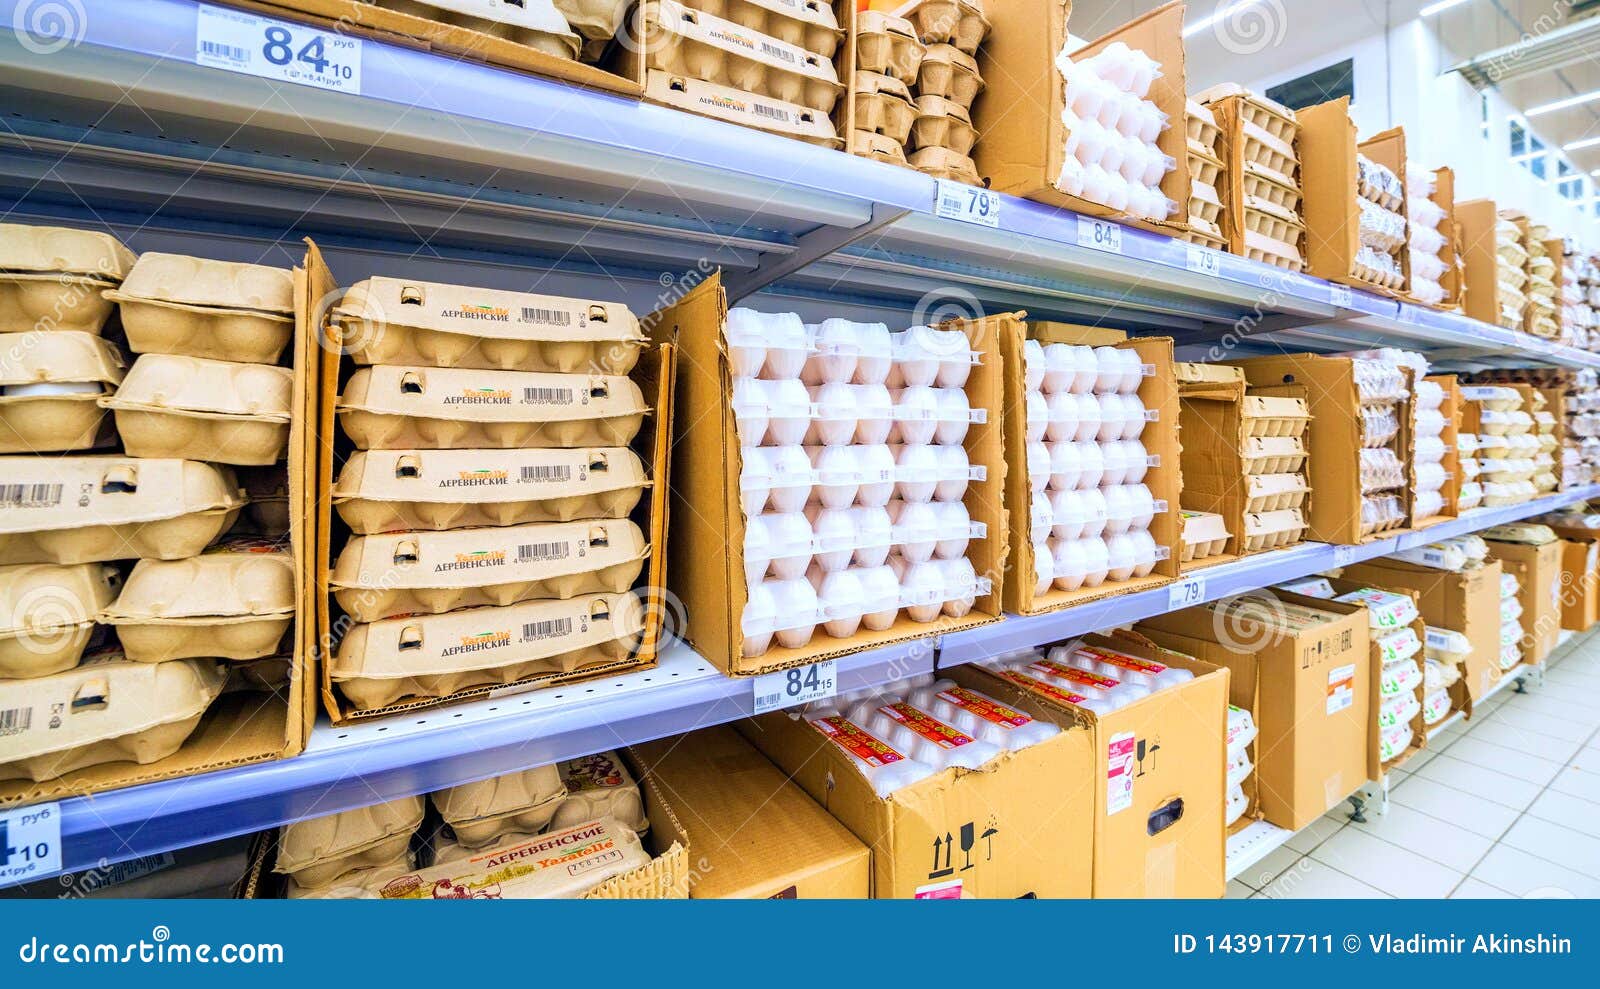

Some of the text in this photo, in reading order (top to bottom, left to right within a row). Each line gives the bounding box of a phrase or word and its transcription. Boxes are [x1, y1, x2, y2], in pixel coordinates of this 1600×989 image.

[263, 26, 329, 73] 84
[333, 38, 354, 49] руб
[331, 63, 352, 80] 10
[967, 189, 990, 217] 79
[1094, 222, 1113, 246] 84
[1199, 250, 1214, 270] 79
[441, 310, 510, 322] ДЕРЕВЕНСКИЕ
[443, 396, 512, 406] ДЕРЕВЕНСКИЕ
[439, 477, 509, 488] ДЕРЕВЕНСКИЕ
[434, 557, 506, 573] ДЕРЕВЕНСКИЕ
[1184, 582, 1199, 602] 79
[441, 637, 512, 658] ДЕРЕВЕНСКИЕ
[786, 663, 821, 698] 84
[820, 678, 833, 690] 15
[21, 808, 50, 826] руб
[20, 842, 49, 862] 10
[486, 826, 606, 869] ДЕРЕВЕНСКИЕ
[536, 839, 615, 870] Yaratelle
